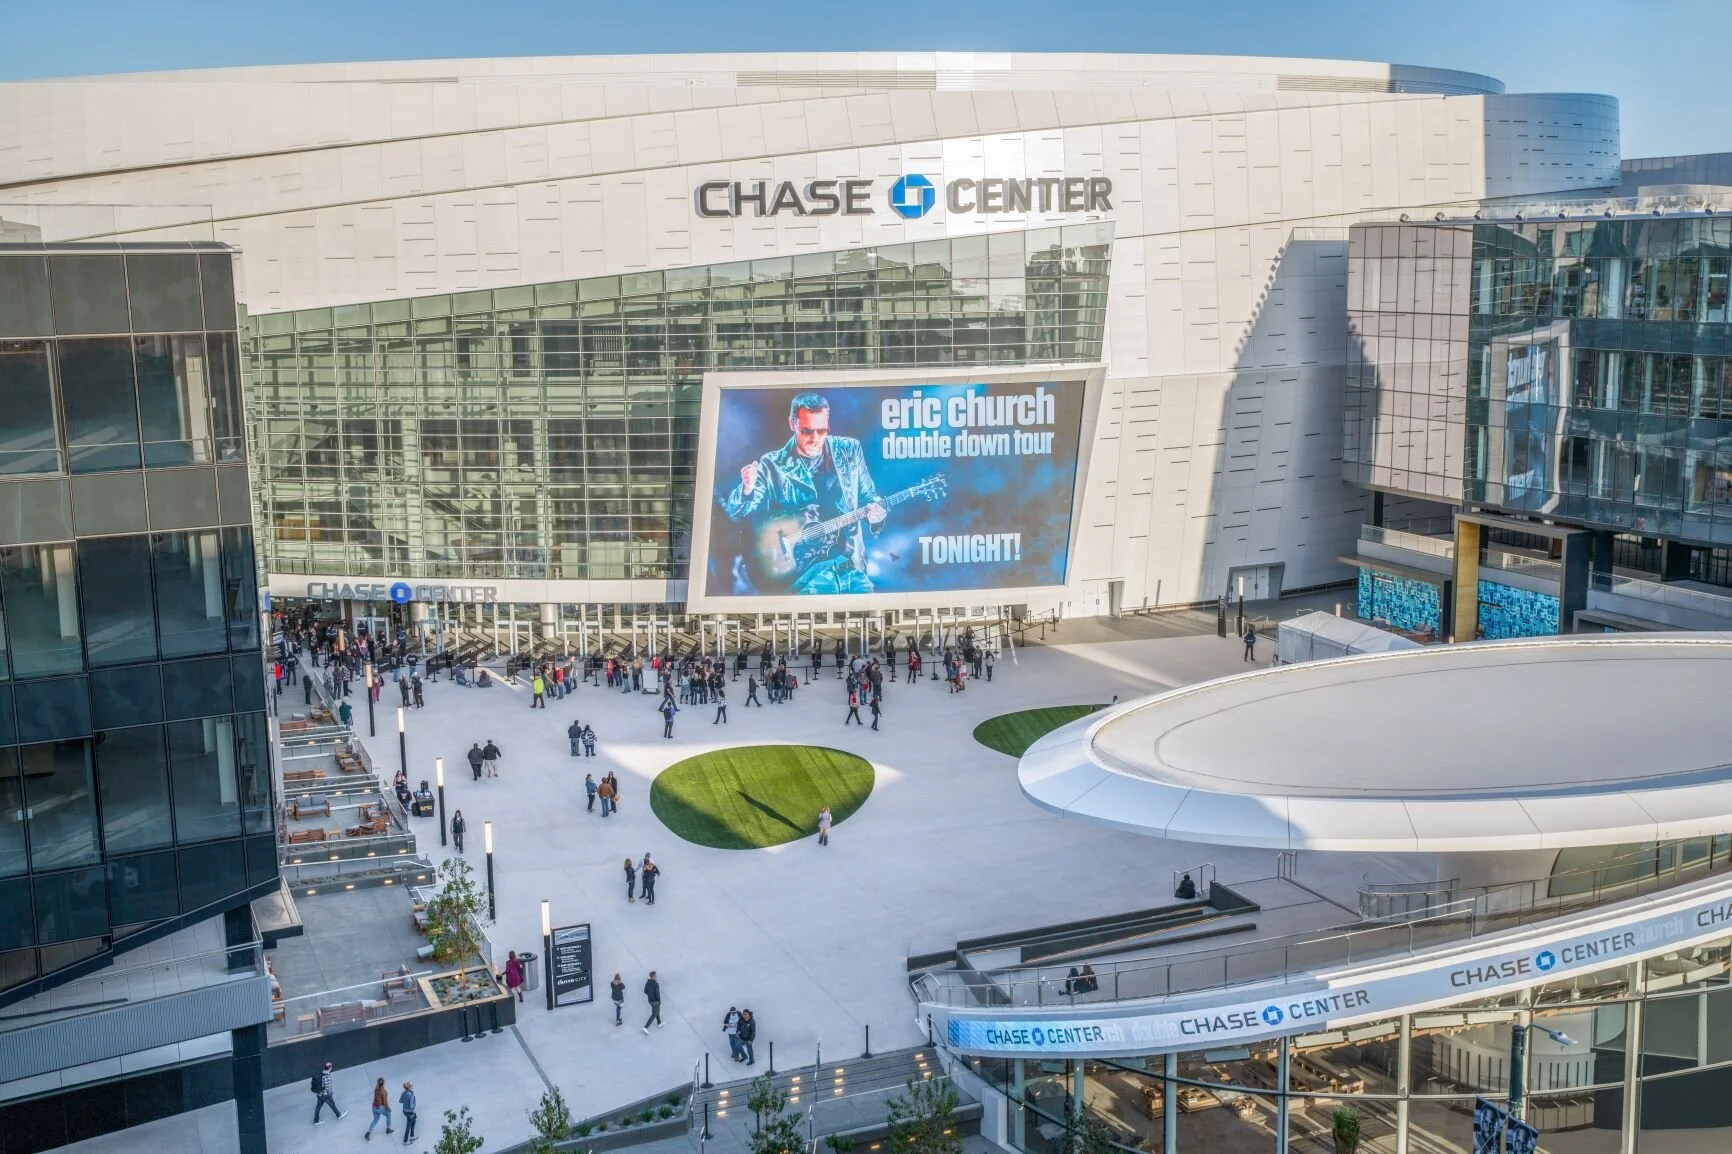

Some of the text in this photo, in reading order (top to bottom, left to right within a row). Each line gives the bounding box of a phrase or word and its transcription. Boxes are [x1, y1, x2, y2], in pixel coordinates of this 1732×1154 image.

[694, 177, 1113, 218] CHASE CENTER
[881, 386, 1055, 430] eric church
[882, 429, 1055, 460] double down tour
[918, 532, 1021, 565] TONIGHT!
[307, 582, 499, 603] CHASE CENTER
[1450, 931, 1636, 987] CHASE CENTER
[1180, 989, 1371, 1036] CHASE CENTER
[986, 1029, 1031, 1045] CHASE
[1047, 1025, 1104, 1045] CENTER
